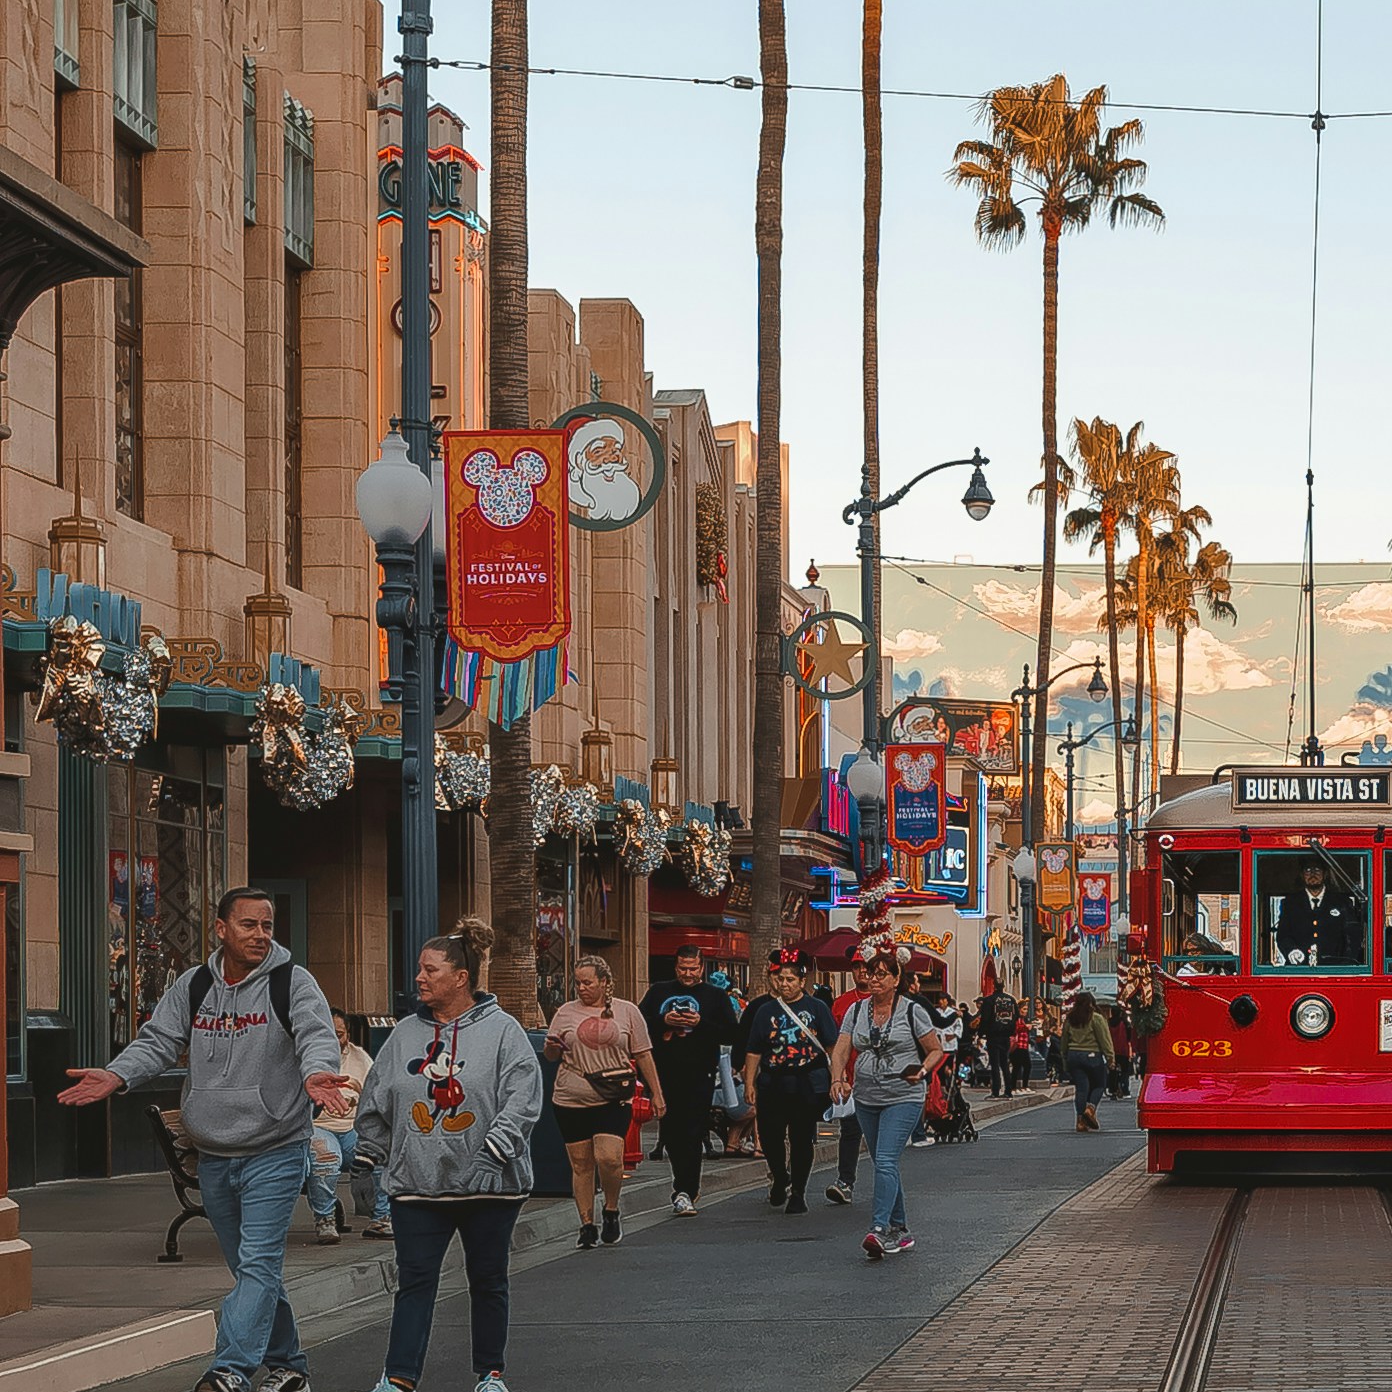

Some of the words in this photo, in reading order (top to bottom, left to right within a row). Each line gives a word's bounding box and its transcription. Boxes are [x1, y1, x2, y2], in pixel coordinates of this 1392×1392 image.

[379, 160, 462, 207] GNE
[470, 562, 531, 573] FESTIVAL
[467, 572, 547, 585] HOLIDAYS
[1245, 778, 1301, 801] BUENA
[1307, 778, 1354, 801] VISTA
[1359, 778, 1380, 800] ST
[1172, 1040, 1233, 1057] 623
